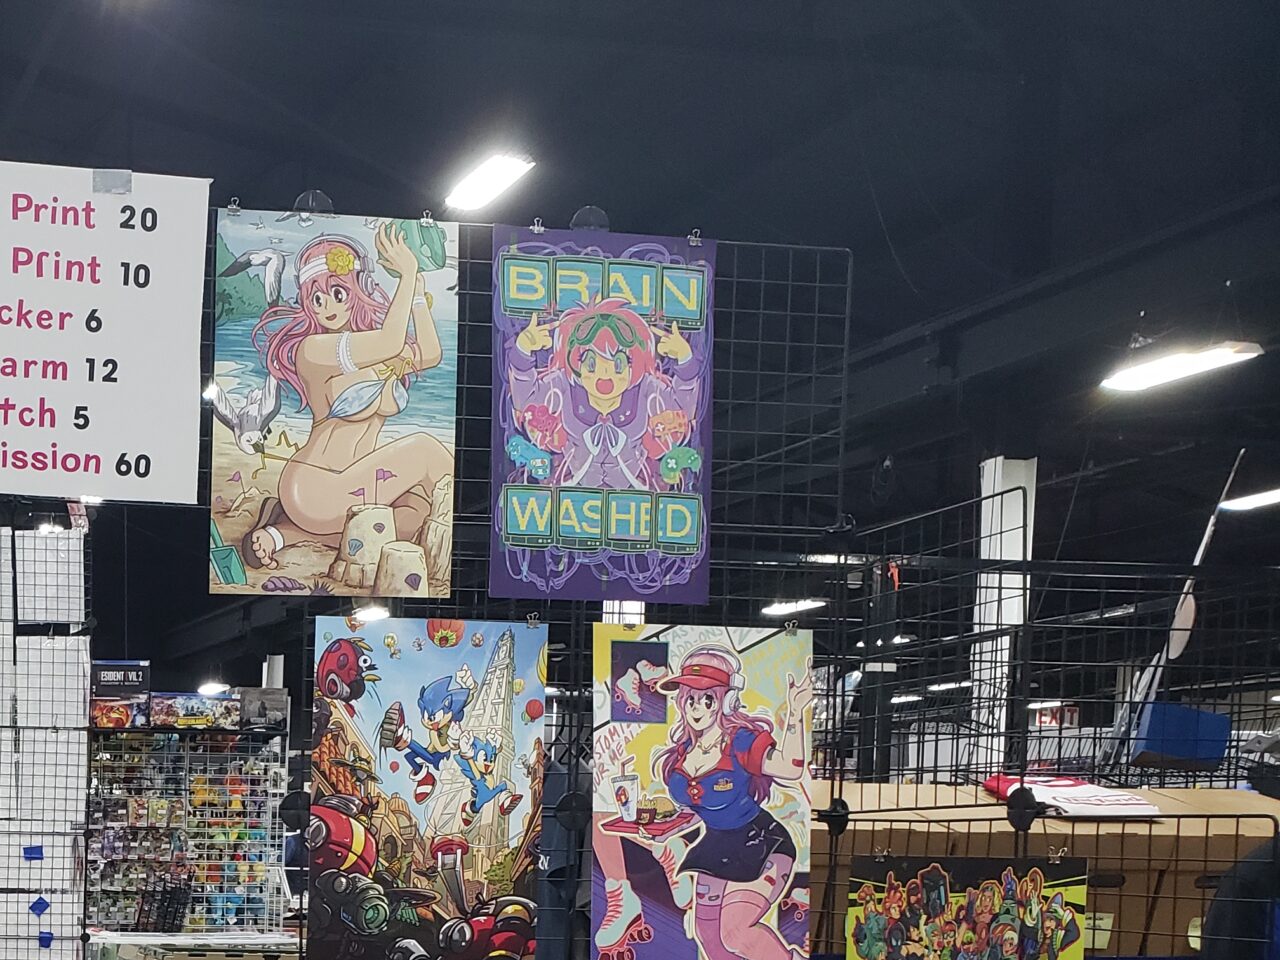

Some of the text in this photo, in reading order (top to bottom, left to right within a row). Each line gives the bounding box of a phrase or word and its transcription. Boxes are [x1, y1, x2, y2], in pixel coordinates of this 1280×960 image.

[11, 193, 96, 229] Print
[120, 205, 158, 232] 20
[11, 247, 102, 284] Print
[120, 262, 151, 288] 10
[508, 265, 697, 311] BRAIN
[85, 309, 103, 333] 6
[86, 357, 119, 383] 12
[73, 406, 90, 430] 5
[115, 452, 152, 479] 60
[511, 497, 693, 537] WASHED
[138, 671, 143, 681] 2
[1037, 707, 1078, 726] EXT
